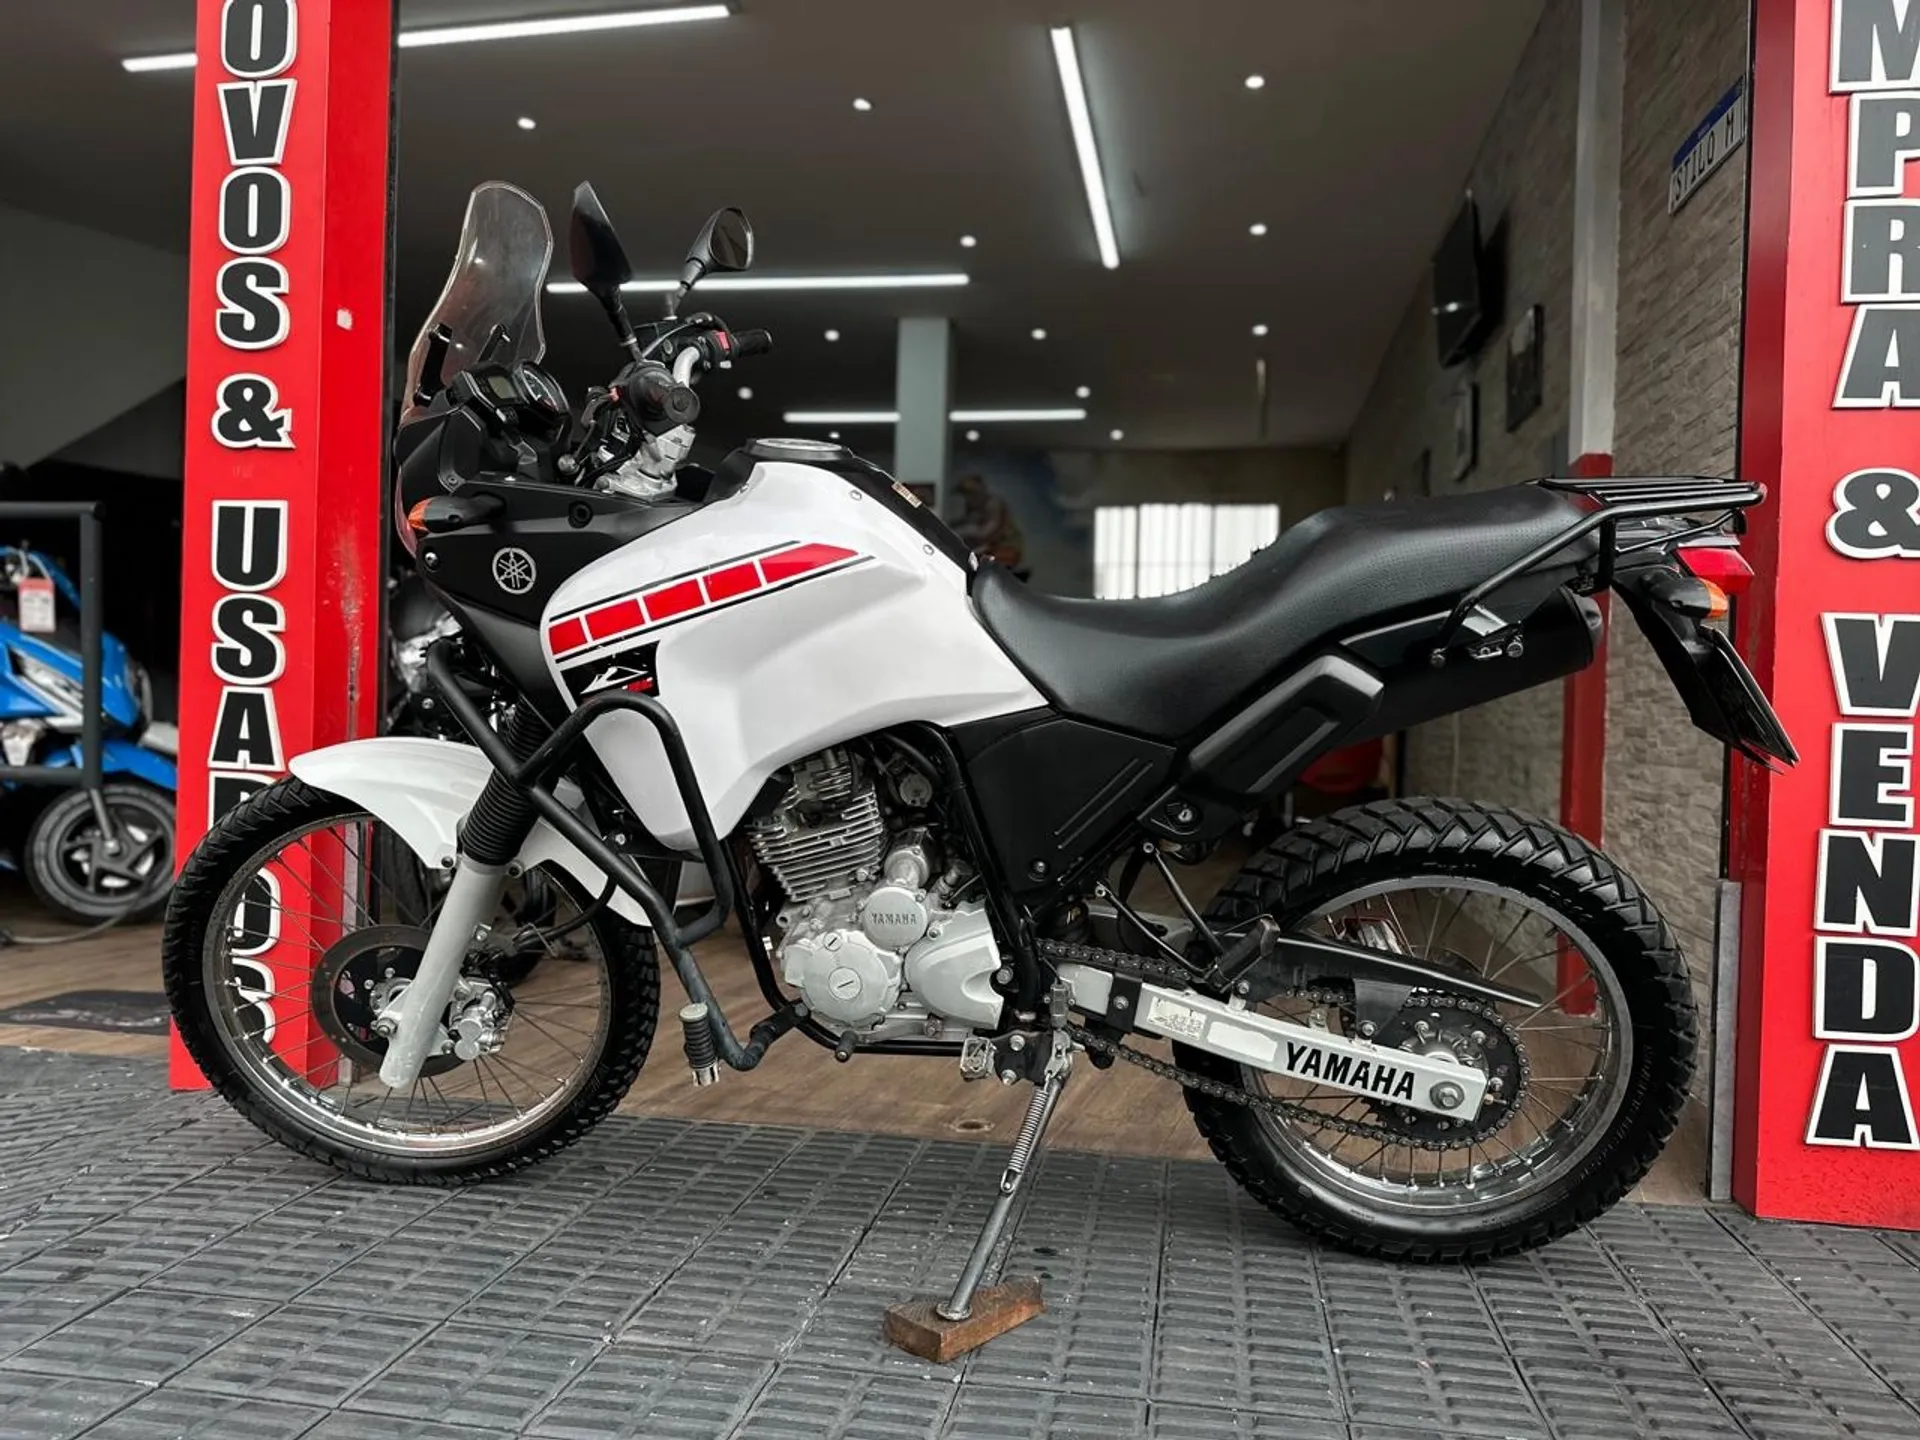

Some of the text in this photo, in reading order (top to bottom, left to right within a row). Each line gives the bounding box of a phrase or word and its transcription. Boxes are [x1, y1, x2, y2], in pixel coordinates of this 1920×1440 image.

[211, 373, 297, 449] &
[1825, 467, 1920, 560] &
[870, 911, 917, 926] YAMAHA
[1805, 612, 1920, 1150] VENDA
[1284, 1041, 1415, 1101] YAMAHA
